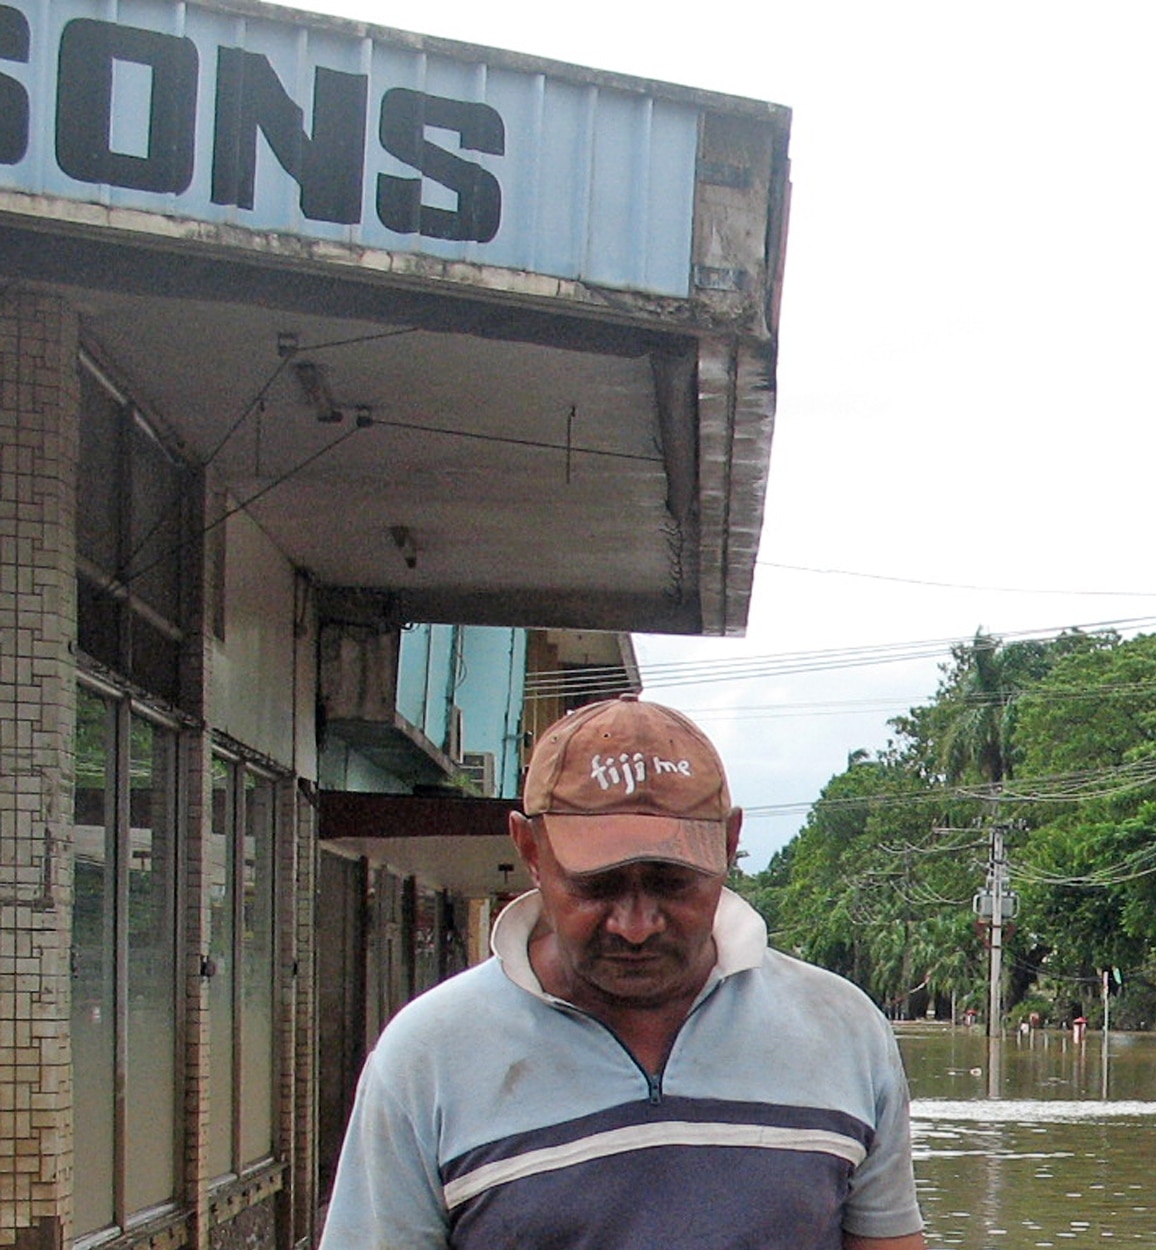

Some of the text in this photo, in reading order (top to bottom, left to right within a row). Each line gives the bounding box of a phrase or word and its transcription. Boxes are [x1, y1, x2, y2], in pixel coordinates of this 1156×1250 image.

[0, 5, 506, 244] ONS
[591, 753, 693, 794] fiji me
